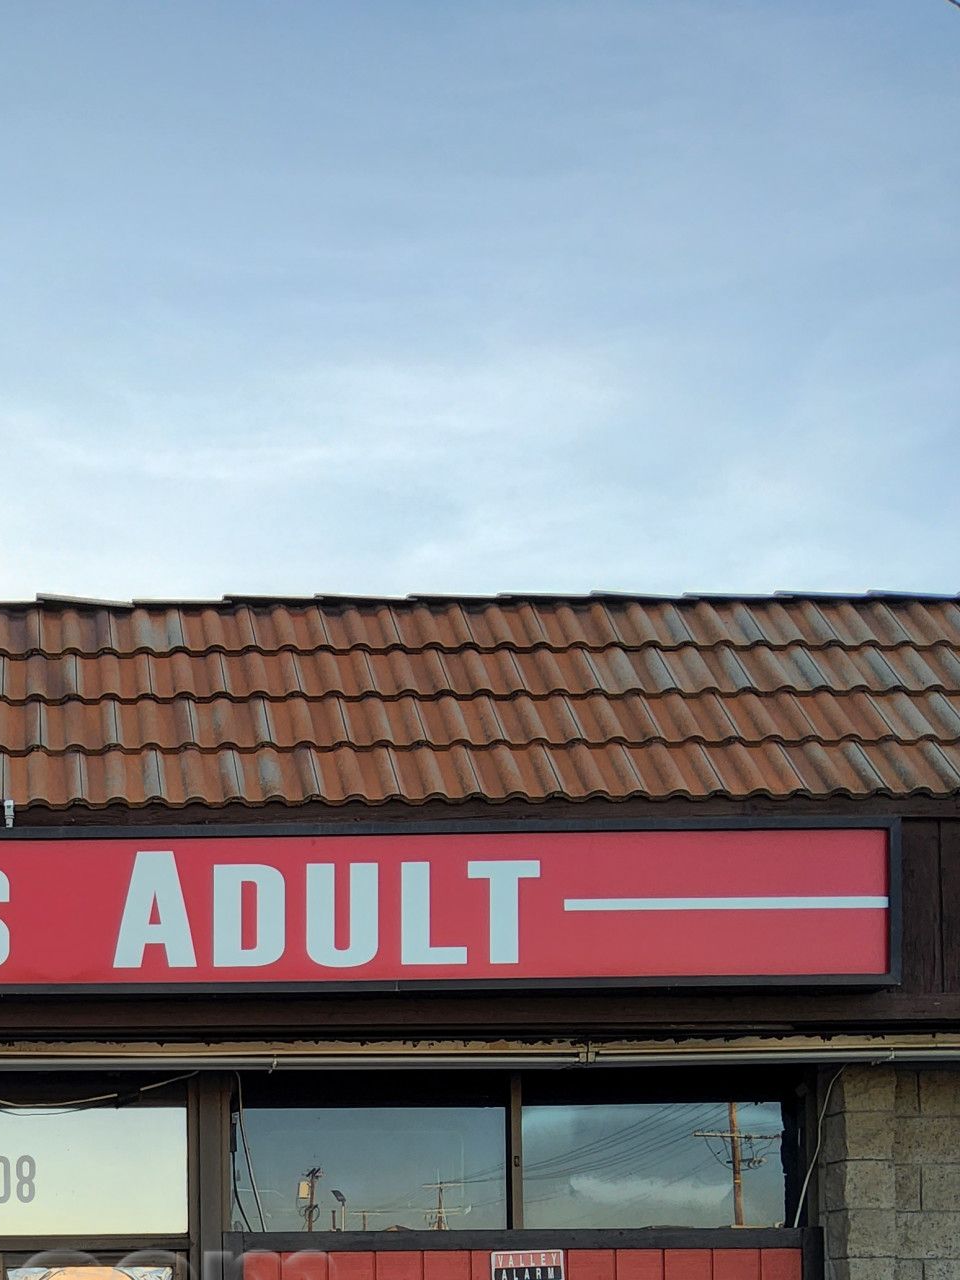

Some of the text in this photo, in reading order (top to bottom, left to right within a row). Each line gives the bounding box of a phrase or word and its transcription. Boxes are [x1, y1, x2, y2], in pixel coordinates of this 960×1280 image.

[112, 850, 541, 968] ADULT
[498, 1253, 557, 1267] VALLEY
[501, 1267, 554, 1280] ALARM
